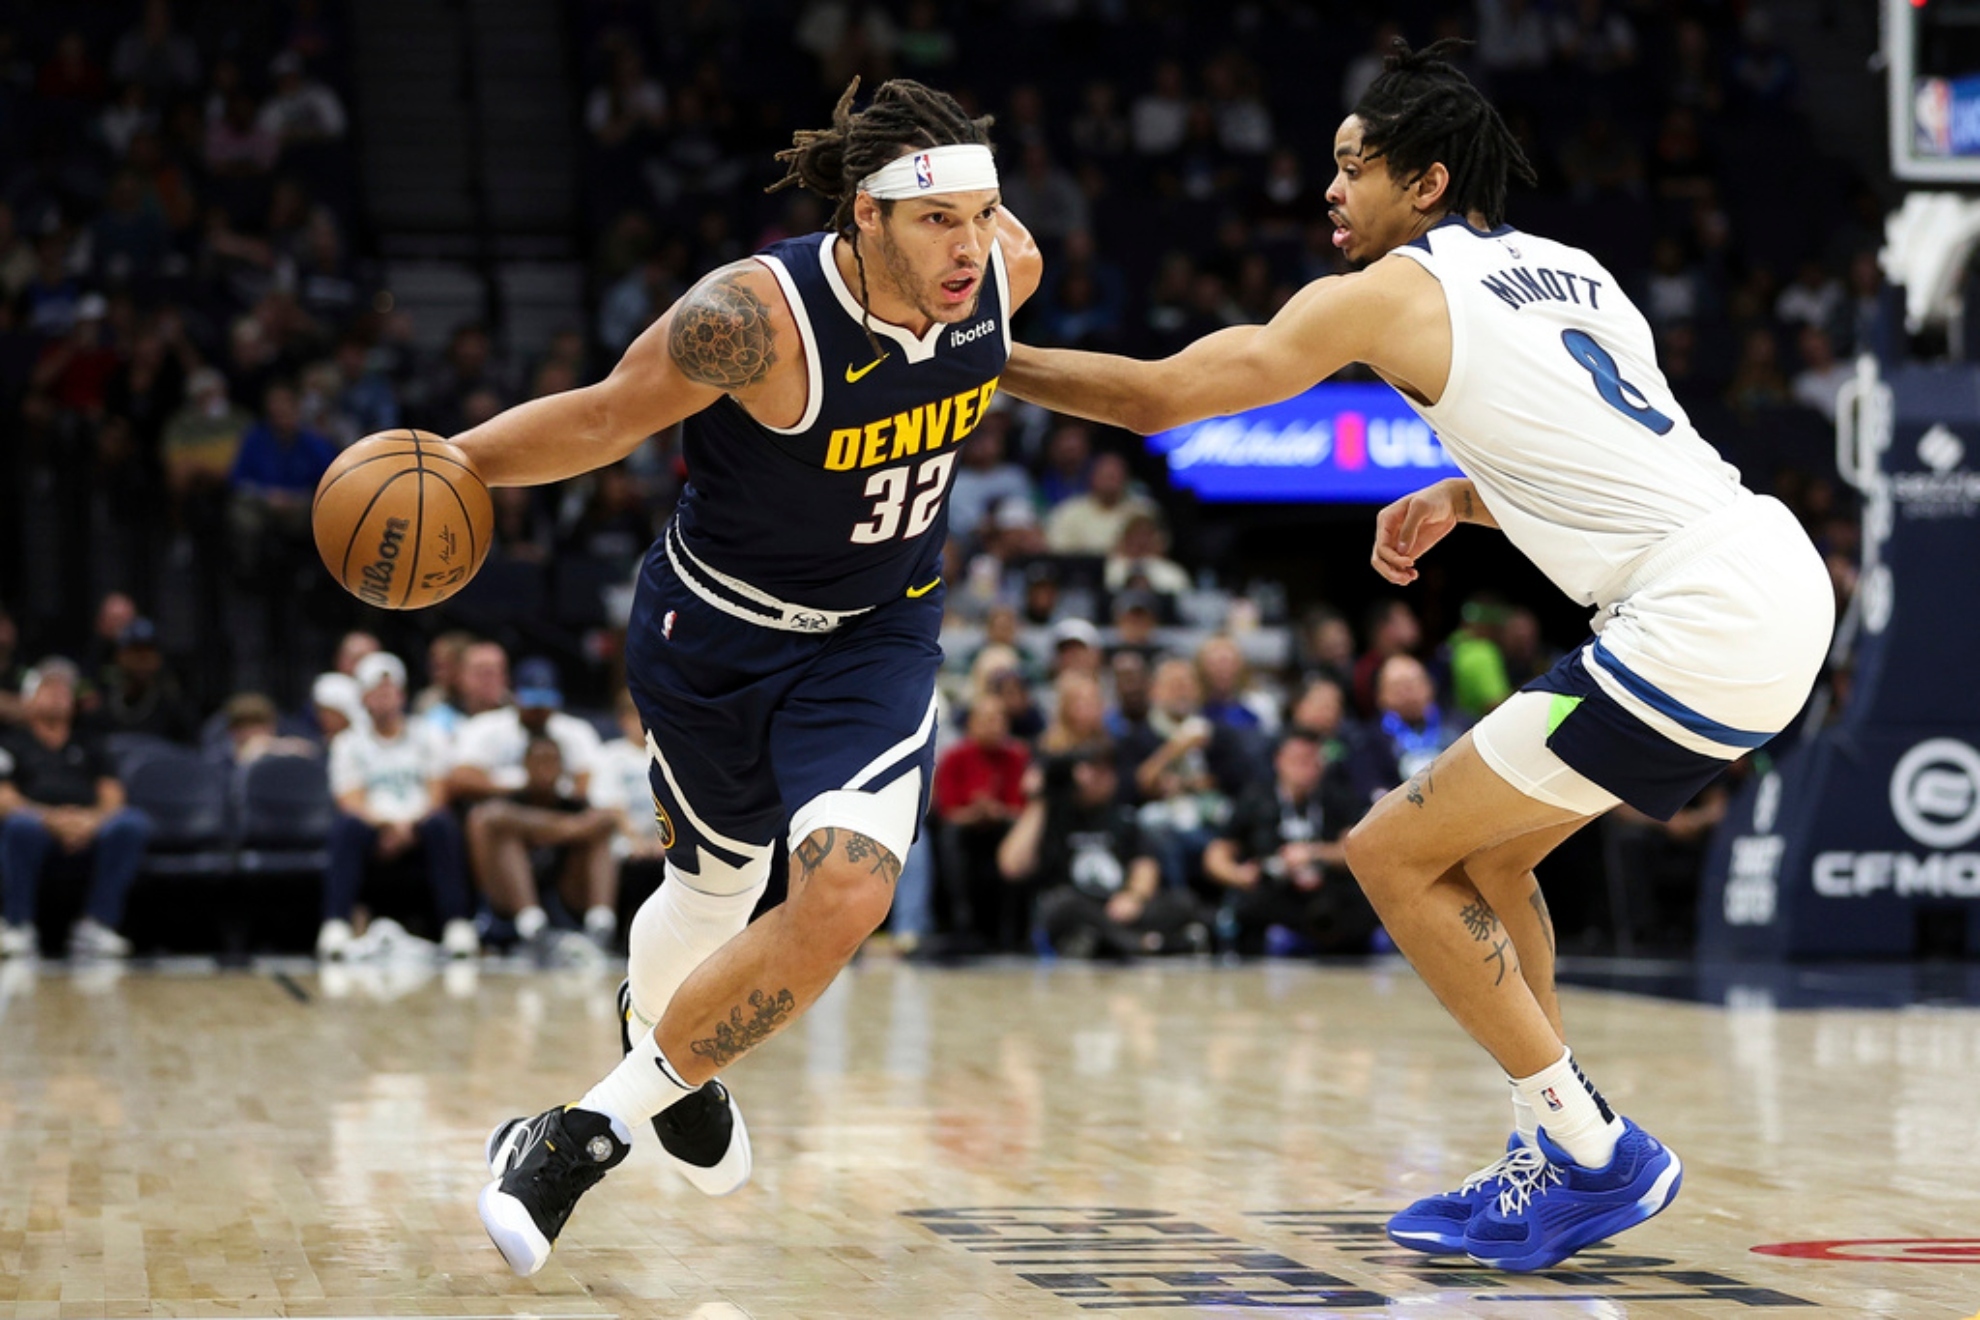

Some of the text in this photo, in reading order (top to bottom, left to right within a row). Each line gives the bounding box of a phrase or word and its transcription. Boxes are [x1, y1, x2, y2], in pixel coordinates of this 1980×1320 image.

[1480, 266, 1602, 310] MINOTT
[950, 318, 996, 347] ibotta
[1561, 327, 1675, 437] 8
[850, 450, 957, 545] 32
